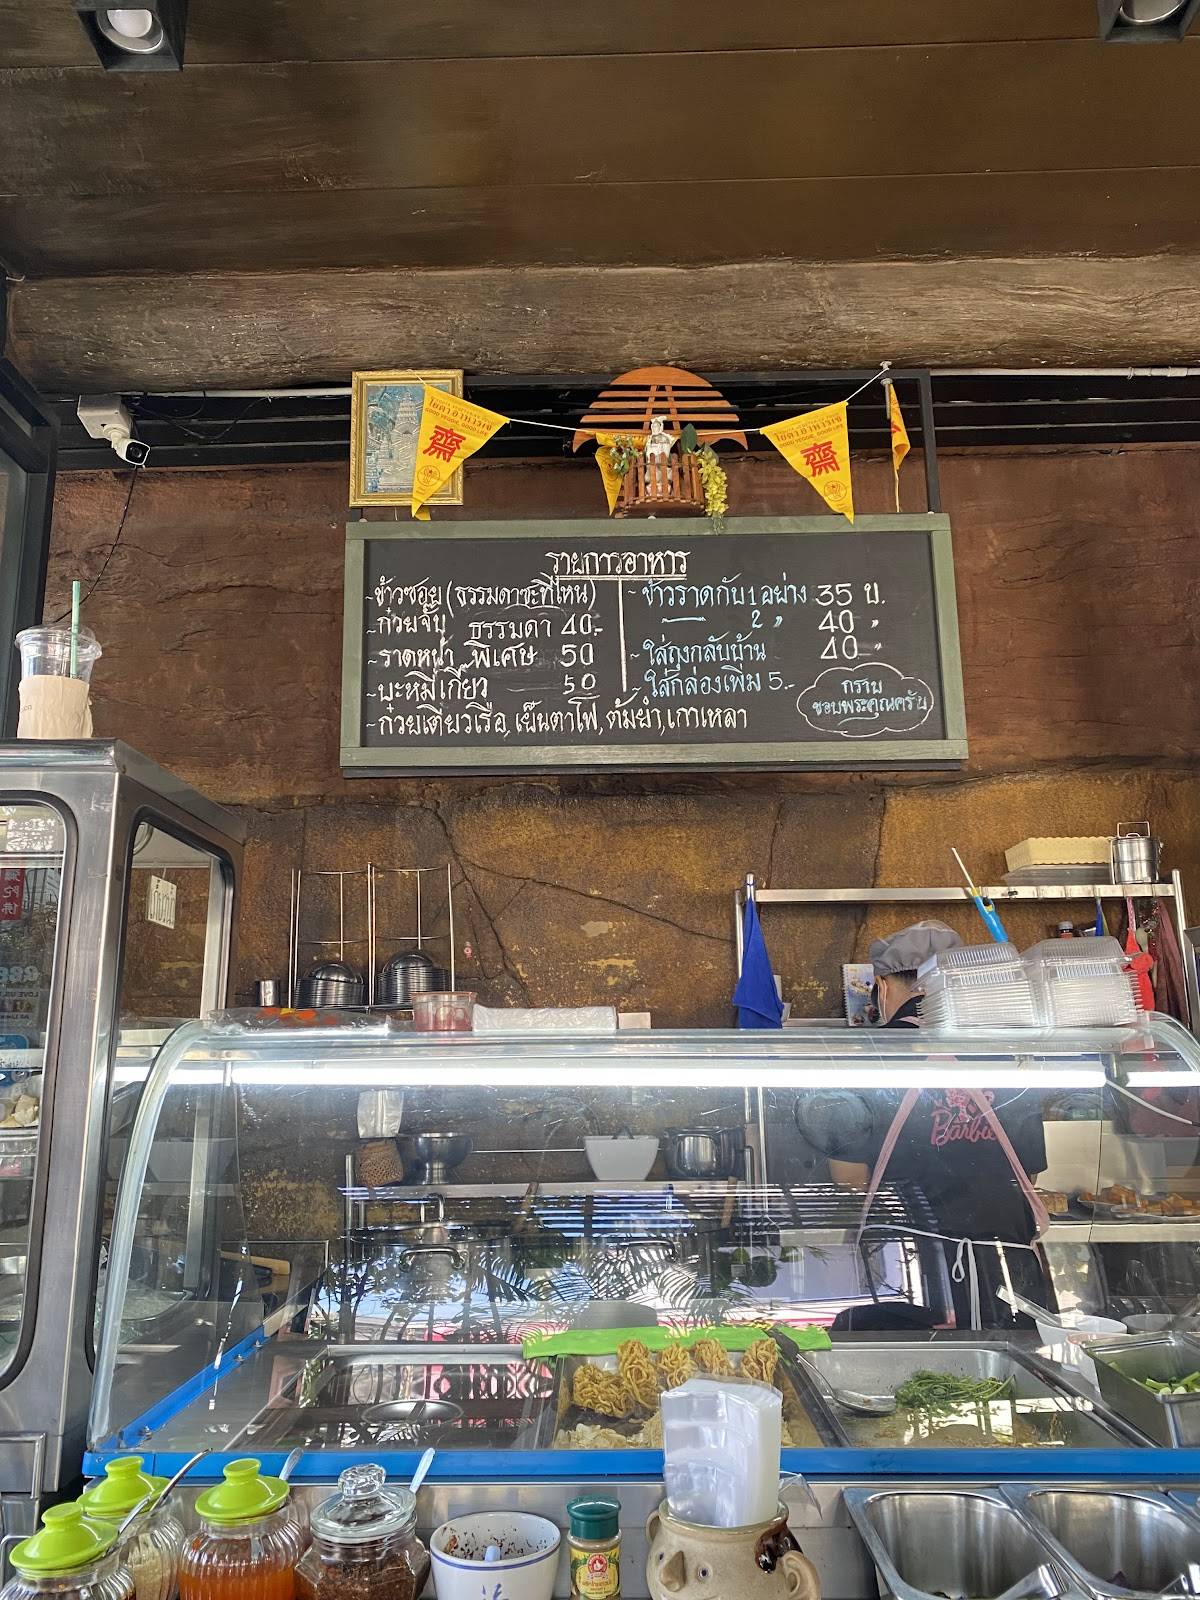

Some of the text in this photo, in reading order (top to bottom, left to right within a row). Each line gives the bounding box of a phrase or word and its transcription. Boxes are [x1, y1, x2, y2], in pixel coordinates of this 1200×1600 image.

[545, 550, 690, 575] รายการอาหาร
[374, 575, 442, 607] ข้าวซอย
[815, 582, 853, 606] 35
[468, 618, 551, 640] ธรรมดา
[751, 609, 763, 629] 2
[818, 609, 856, 633] 40
[378, 635, 594, 669] ราดหน้า พิเศษ 50
[642, 631, 767, 669] ใส่ถุงกลับบ้าน
[820, 634, 859, 660] 40
[562, 673, 597, 695] 50
[644, 665, 762, 698] ใส่กล่องเพิ่ม
[811, 690, 928, 717] ขอบพระคุณครับ
